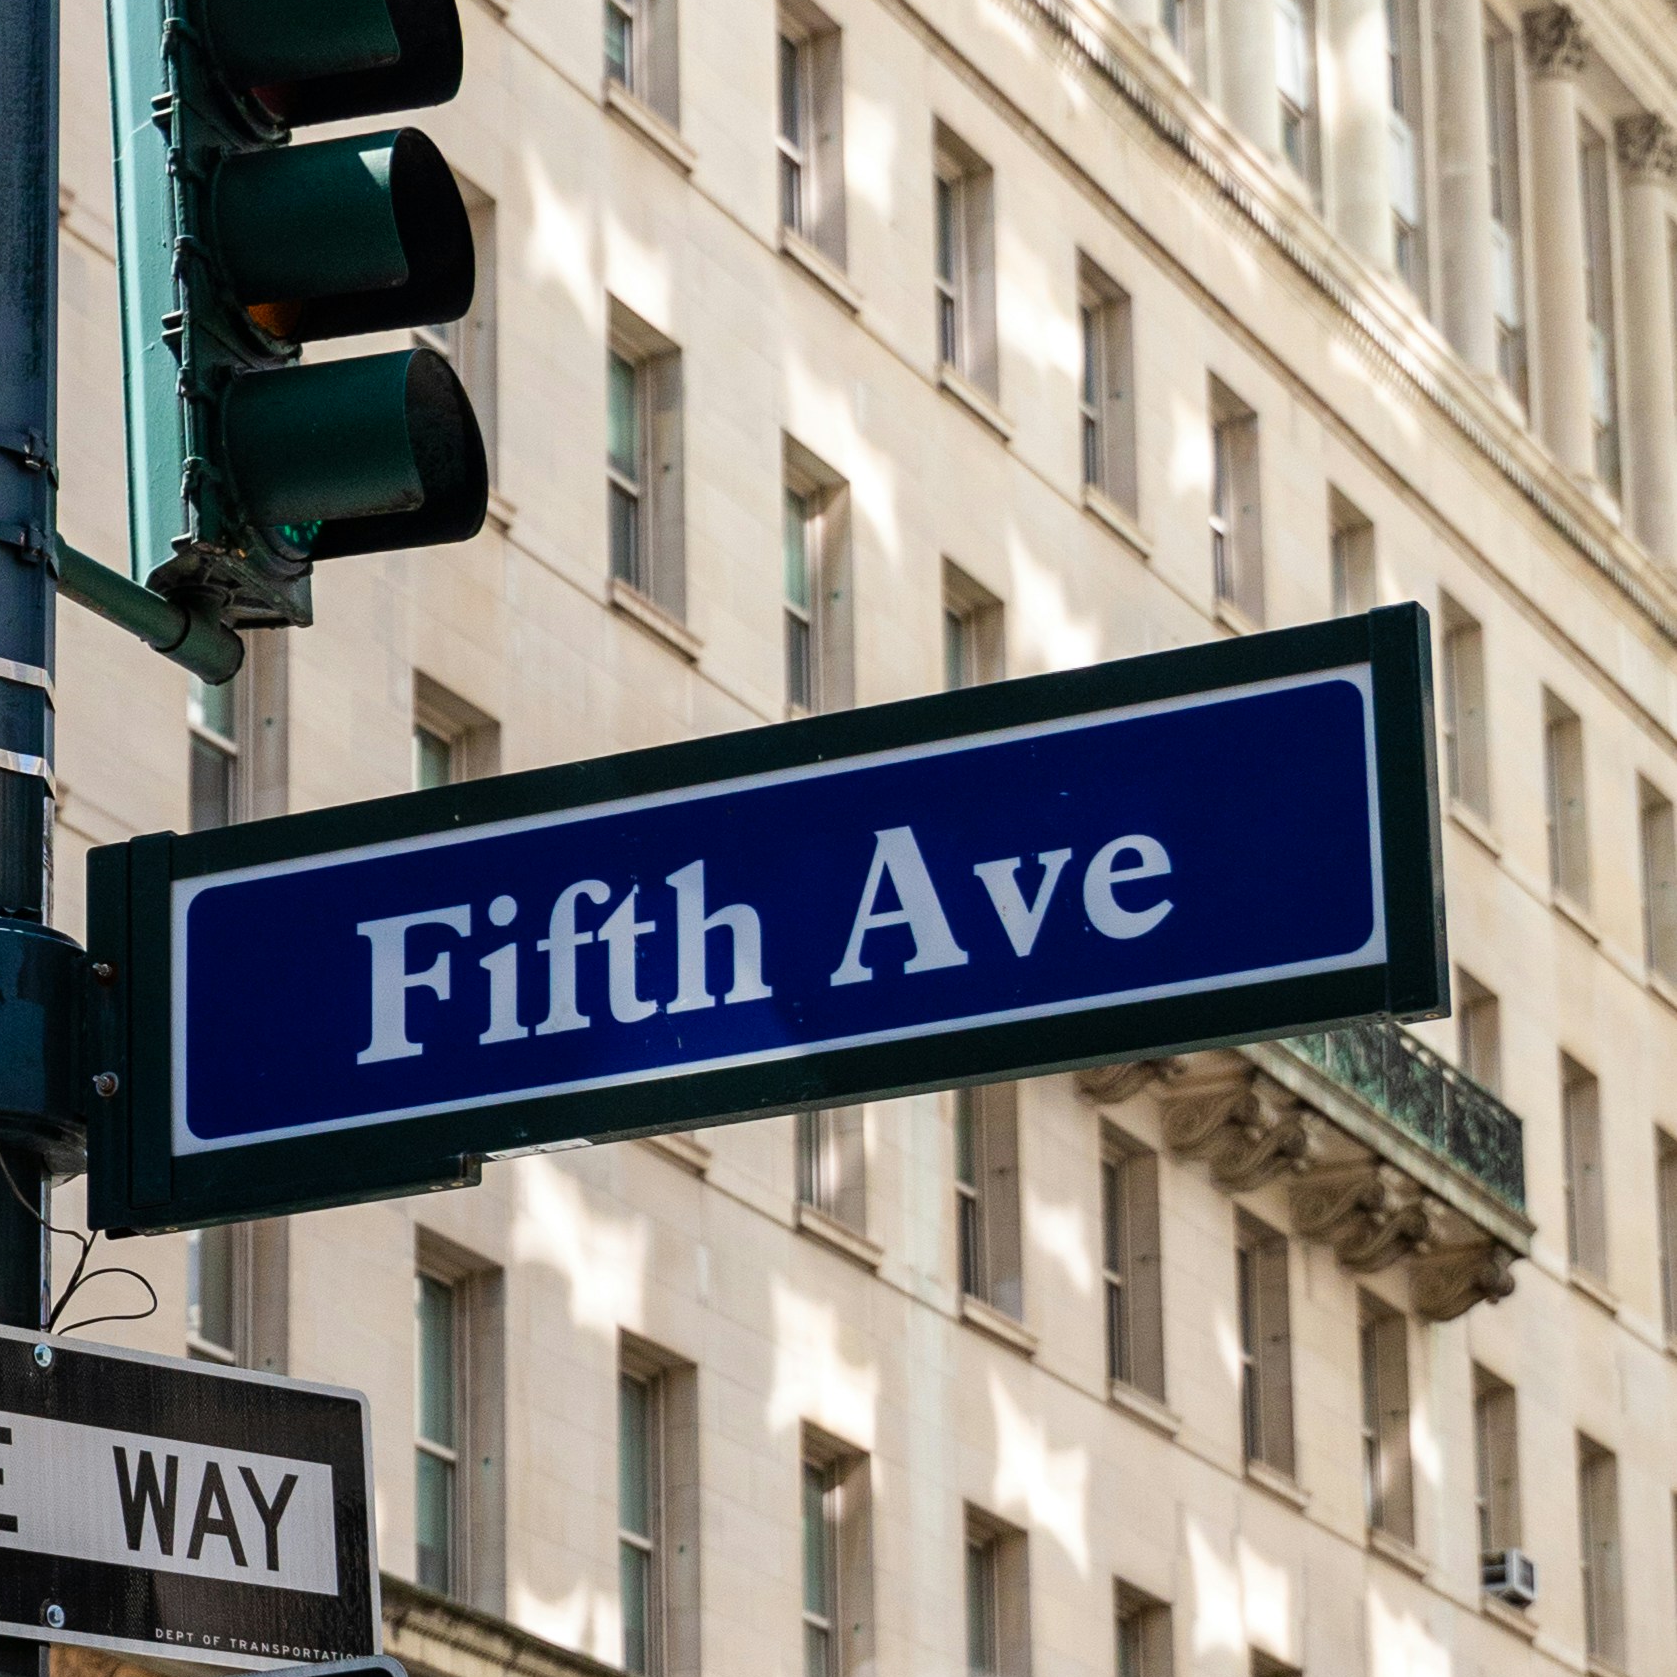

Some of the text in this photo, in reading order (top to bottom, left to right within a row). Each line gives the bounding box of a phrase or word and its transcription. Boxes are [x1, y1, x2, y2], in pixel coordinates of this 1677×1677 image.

[355, 825, 1175, 1066] Fifth Ave
[112, 1445, 298, 1572] WAY
[155, 1627, 362, 1663] DEPT OF TRANSPORTATIO
